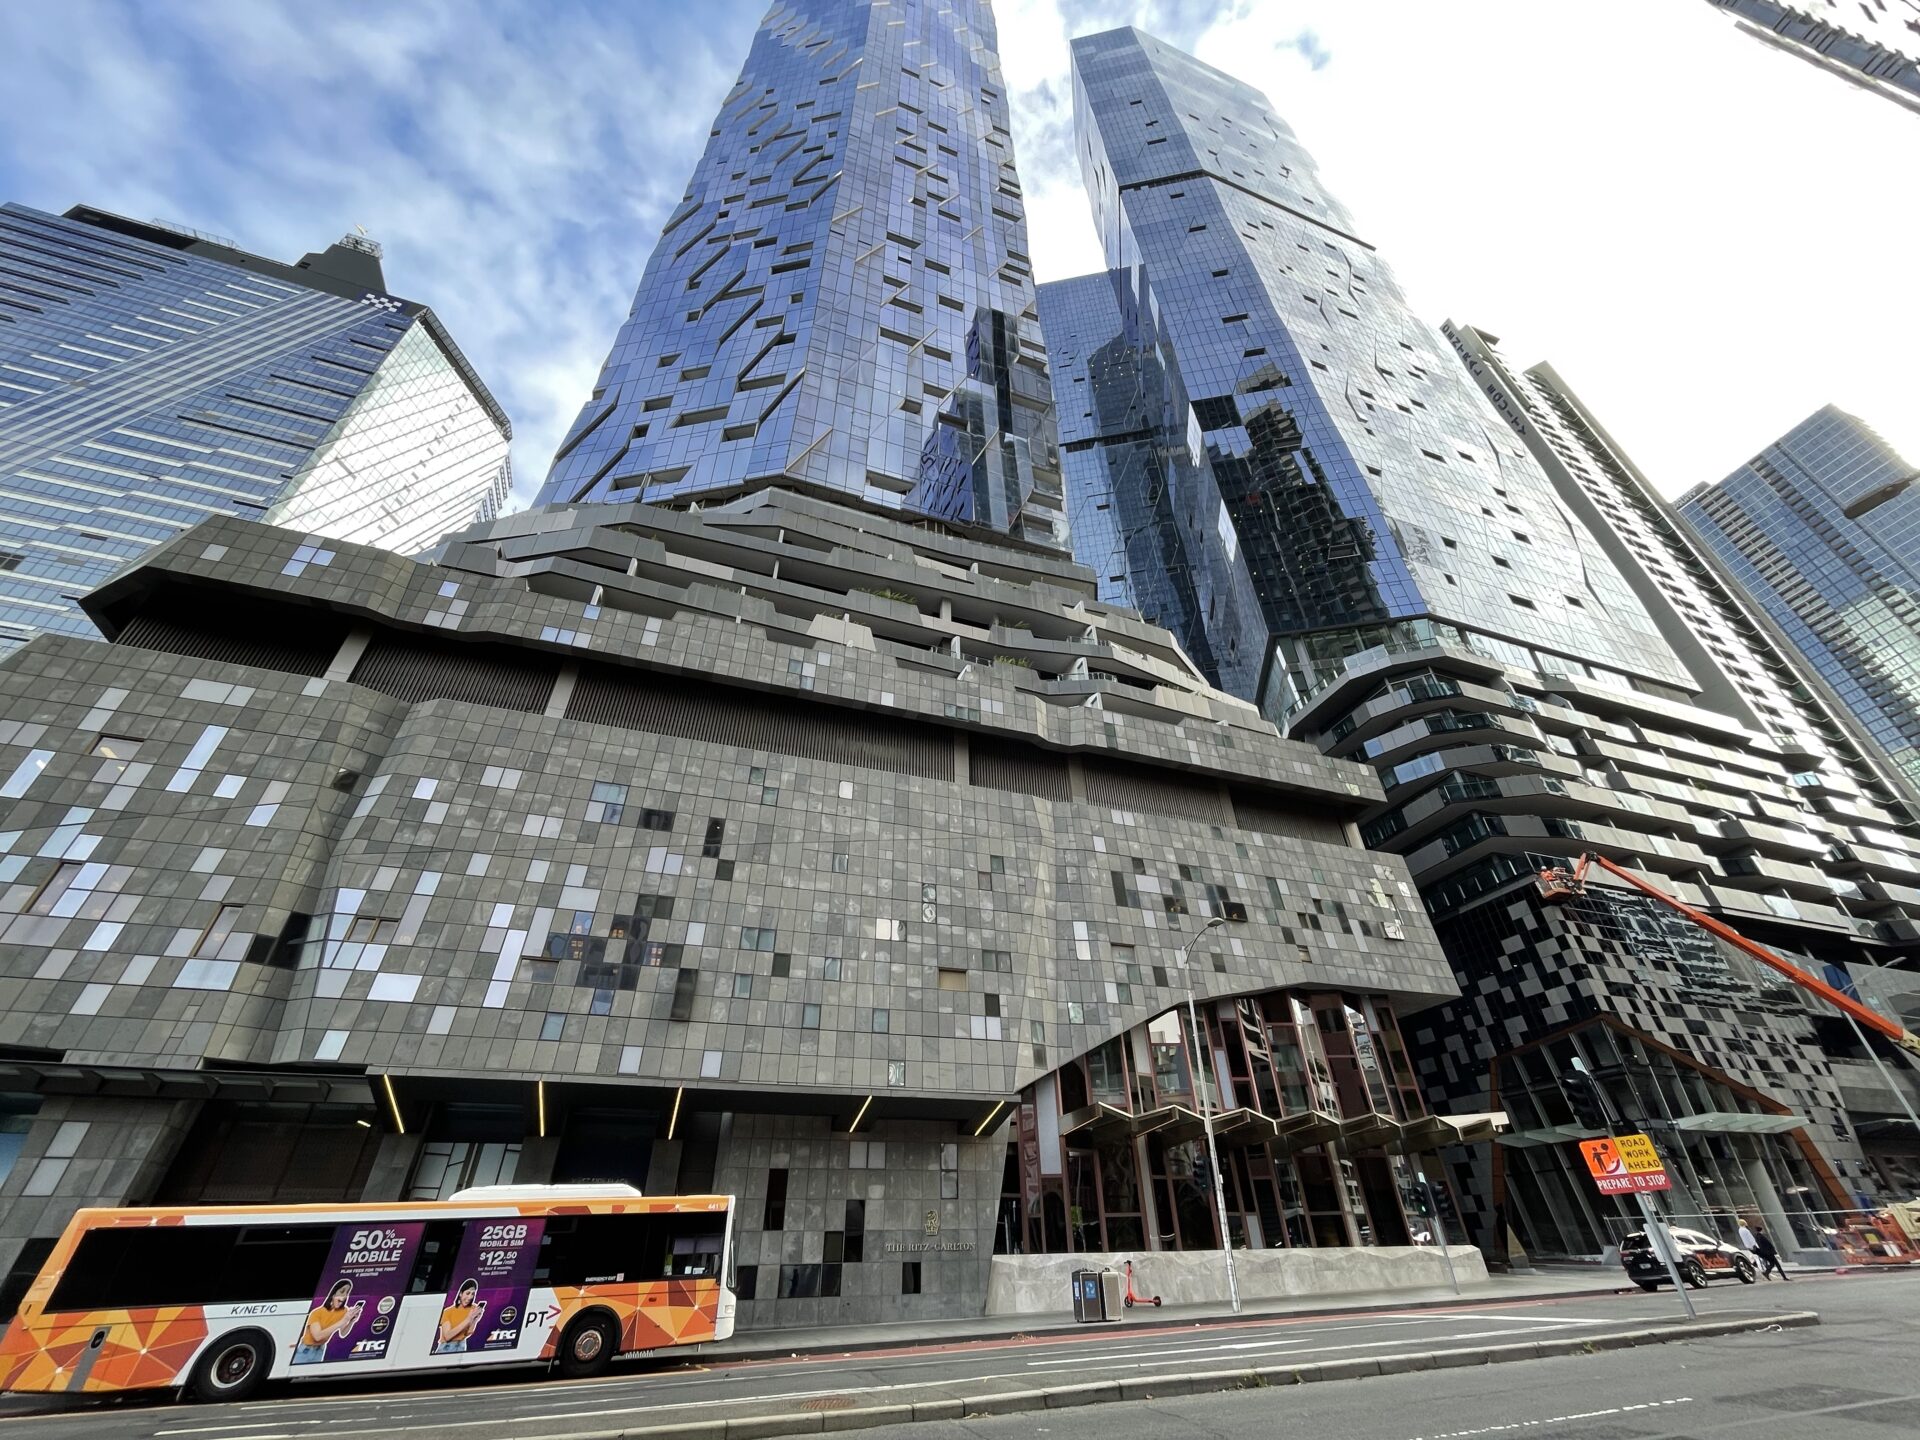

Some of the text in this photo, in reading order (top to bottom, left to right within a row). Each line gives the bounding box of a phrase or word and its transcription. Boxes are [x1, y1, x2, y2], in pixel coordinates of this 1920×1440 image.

[1441, 324, 1526, 435] CENTRAL EQUITY
[1620, 1138, 1646, 1148] ROAD
[1625, 1149, 1651, 1158] WORK
[1627, 1160, 1660, 1170] AHEAD
[1597, 1175, 1666, 1190] PREPARE TO STOP
[481, 1225, 528, 1240] 25GB
[381, 1238, 406, 1249] OFF
[885, 1243, 905, 1253] THE
[344, 1250, 402, 1264] MOBILE
[479, 1251, 517, 1265] $12.50
[490, 1329, 517, 1340] TPG
[353, 1340, 386, 1352] TPG
